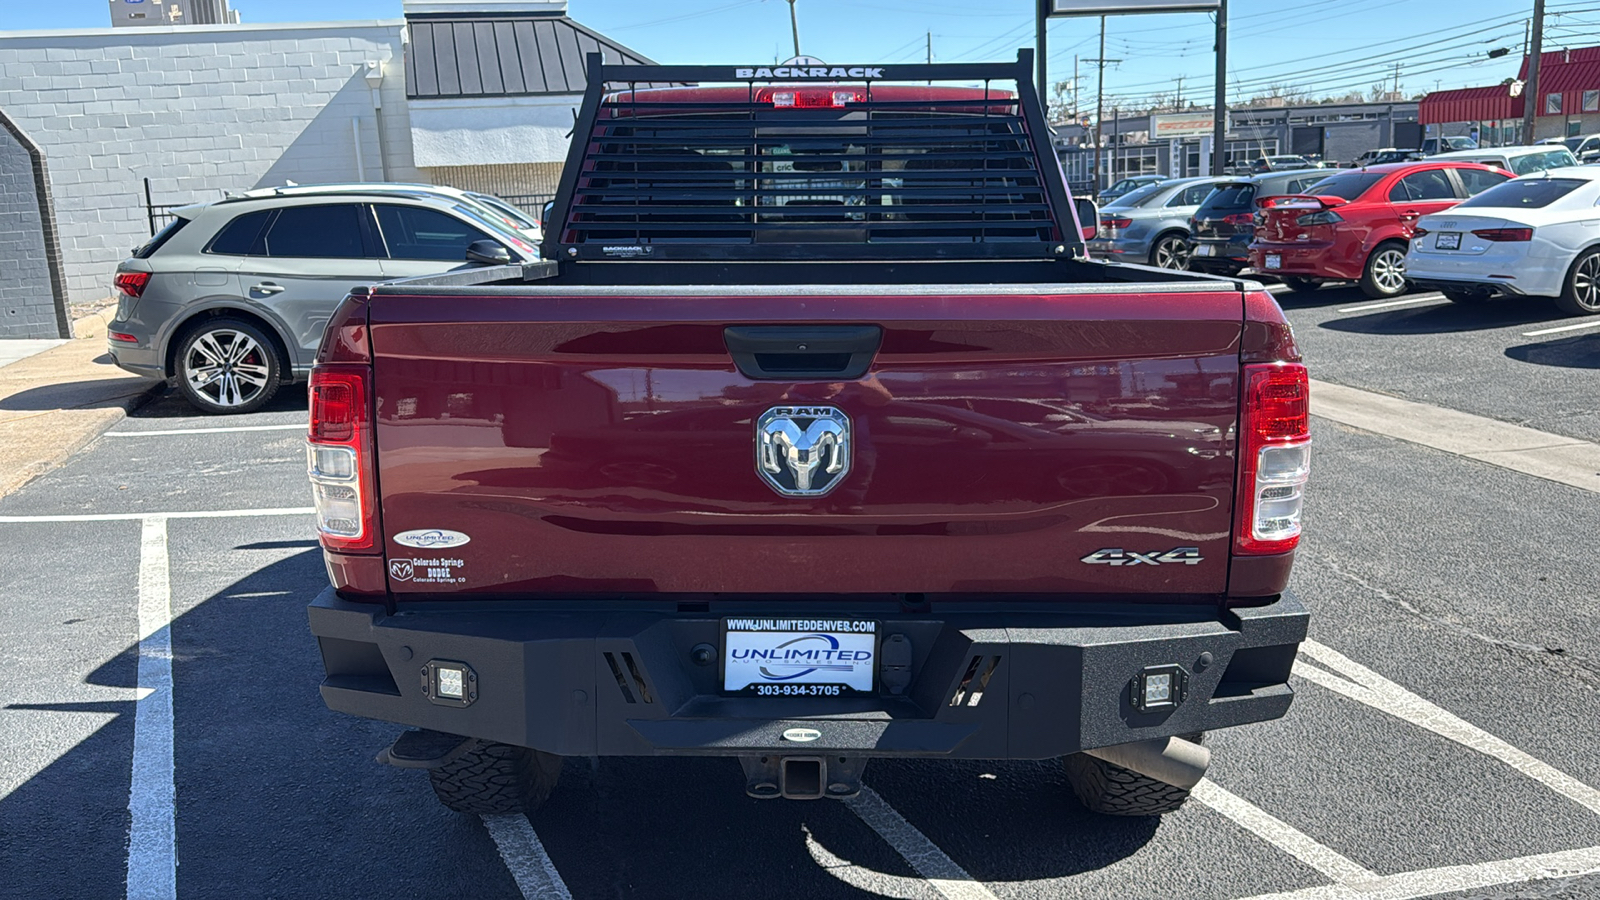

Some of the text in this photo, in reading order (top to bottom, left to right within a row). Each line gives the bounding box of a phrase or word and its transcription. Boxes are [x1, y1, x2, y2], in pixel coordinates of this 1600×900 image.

[735, 67, 883, 78] BACKRACK
[1080, 547, 1205, 566] 4x4
[413, 558, 464, 568] Colorado Springs
[427, 568, 450, 577] DODGE
[727, 619, 875, 632] WWW.UNLIMITEDDENVER.COM
[731, 649, 872, 661] UNLIMITED
[757, 685, 840, 696] 303-934-3705
